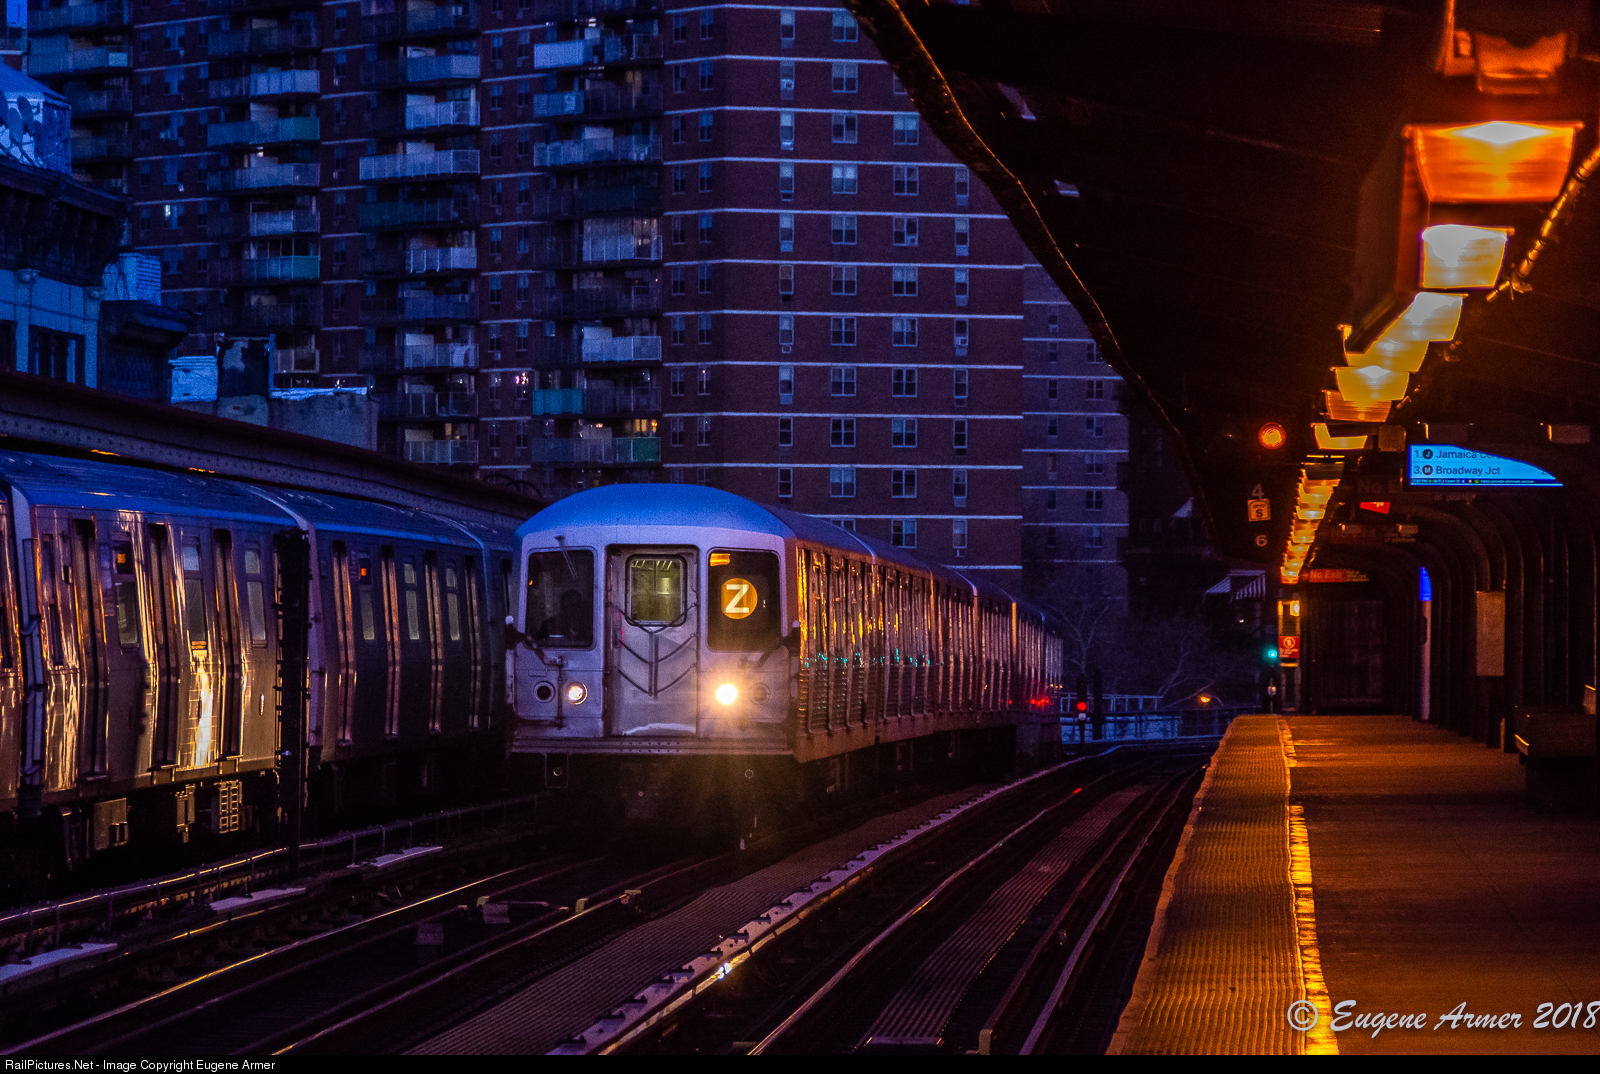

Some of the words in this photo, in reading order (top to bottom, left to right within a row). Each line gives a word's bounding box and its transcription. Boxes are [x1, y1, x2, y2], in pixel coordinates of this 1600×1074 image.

[1436, 449, 1477, 459] Jamaica
[1436, 466, 1483, 477] Broadway
[1485, 466, 1500, 475] Jct
[1251, 483, 1264, 498] 4
[1256, 508, 1263, 518] S
[1255, 534, 1268, 547] 6
[725, 584, 749, 613] Z
